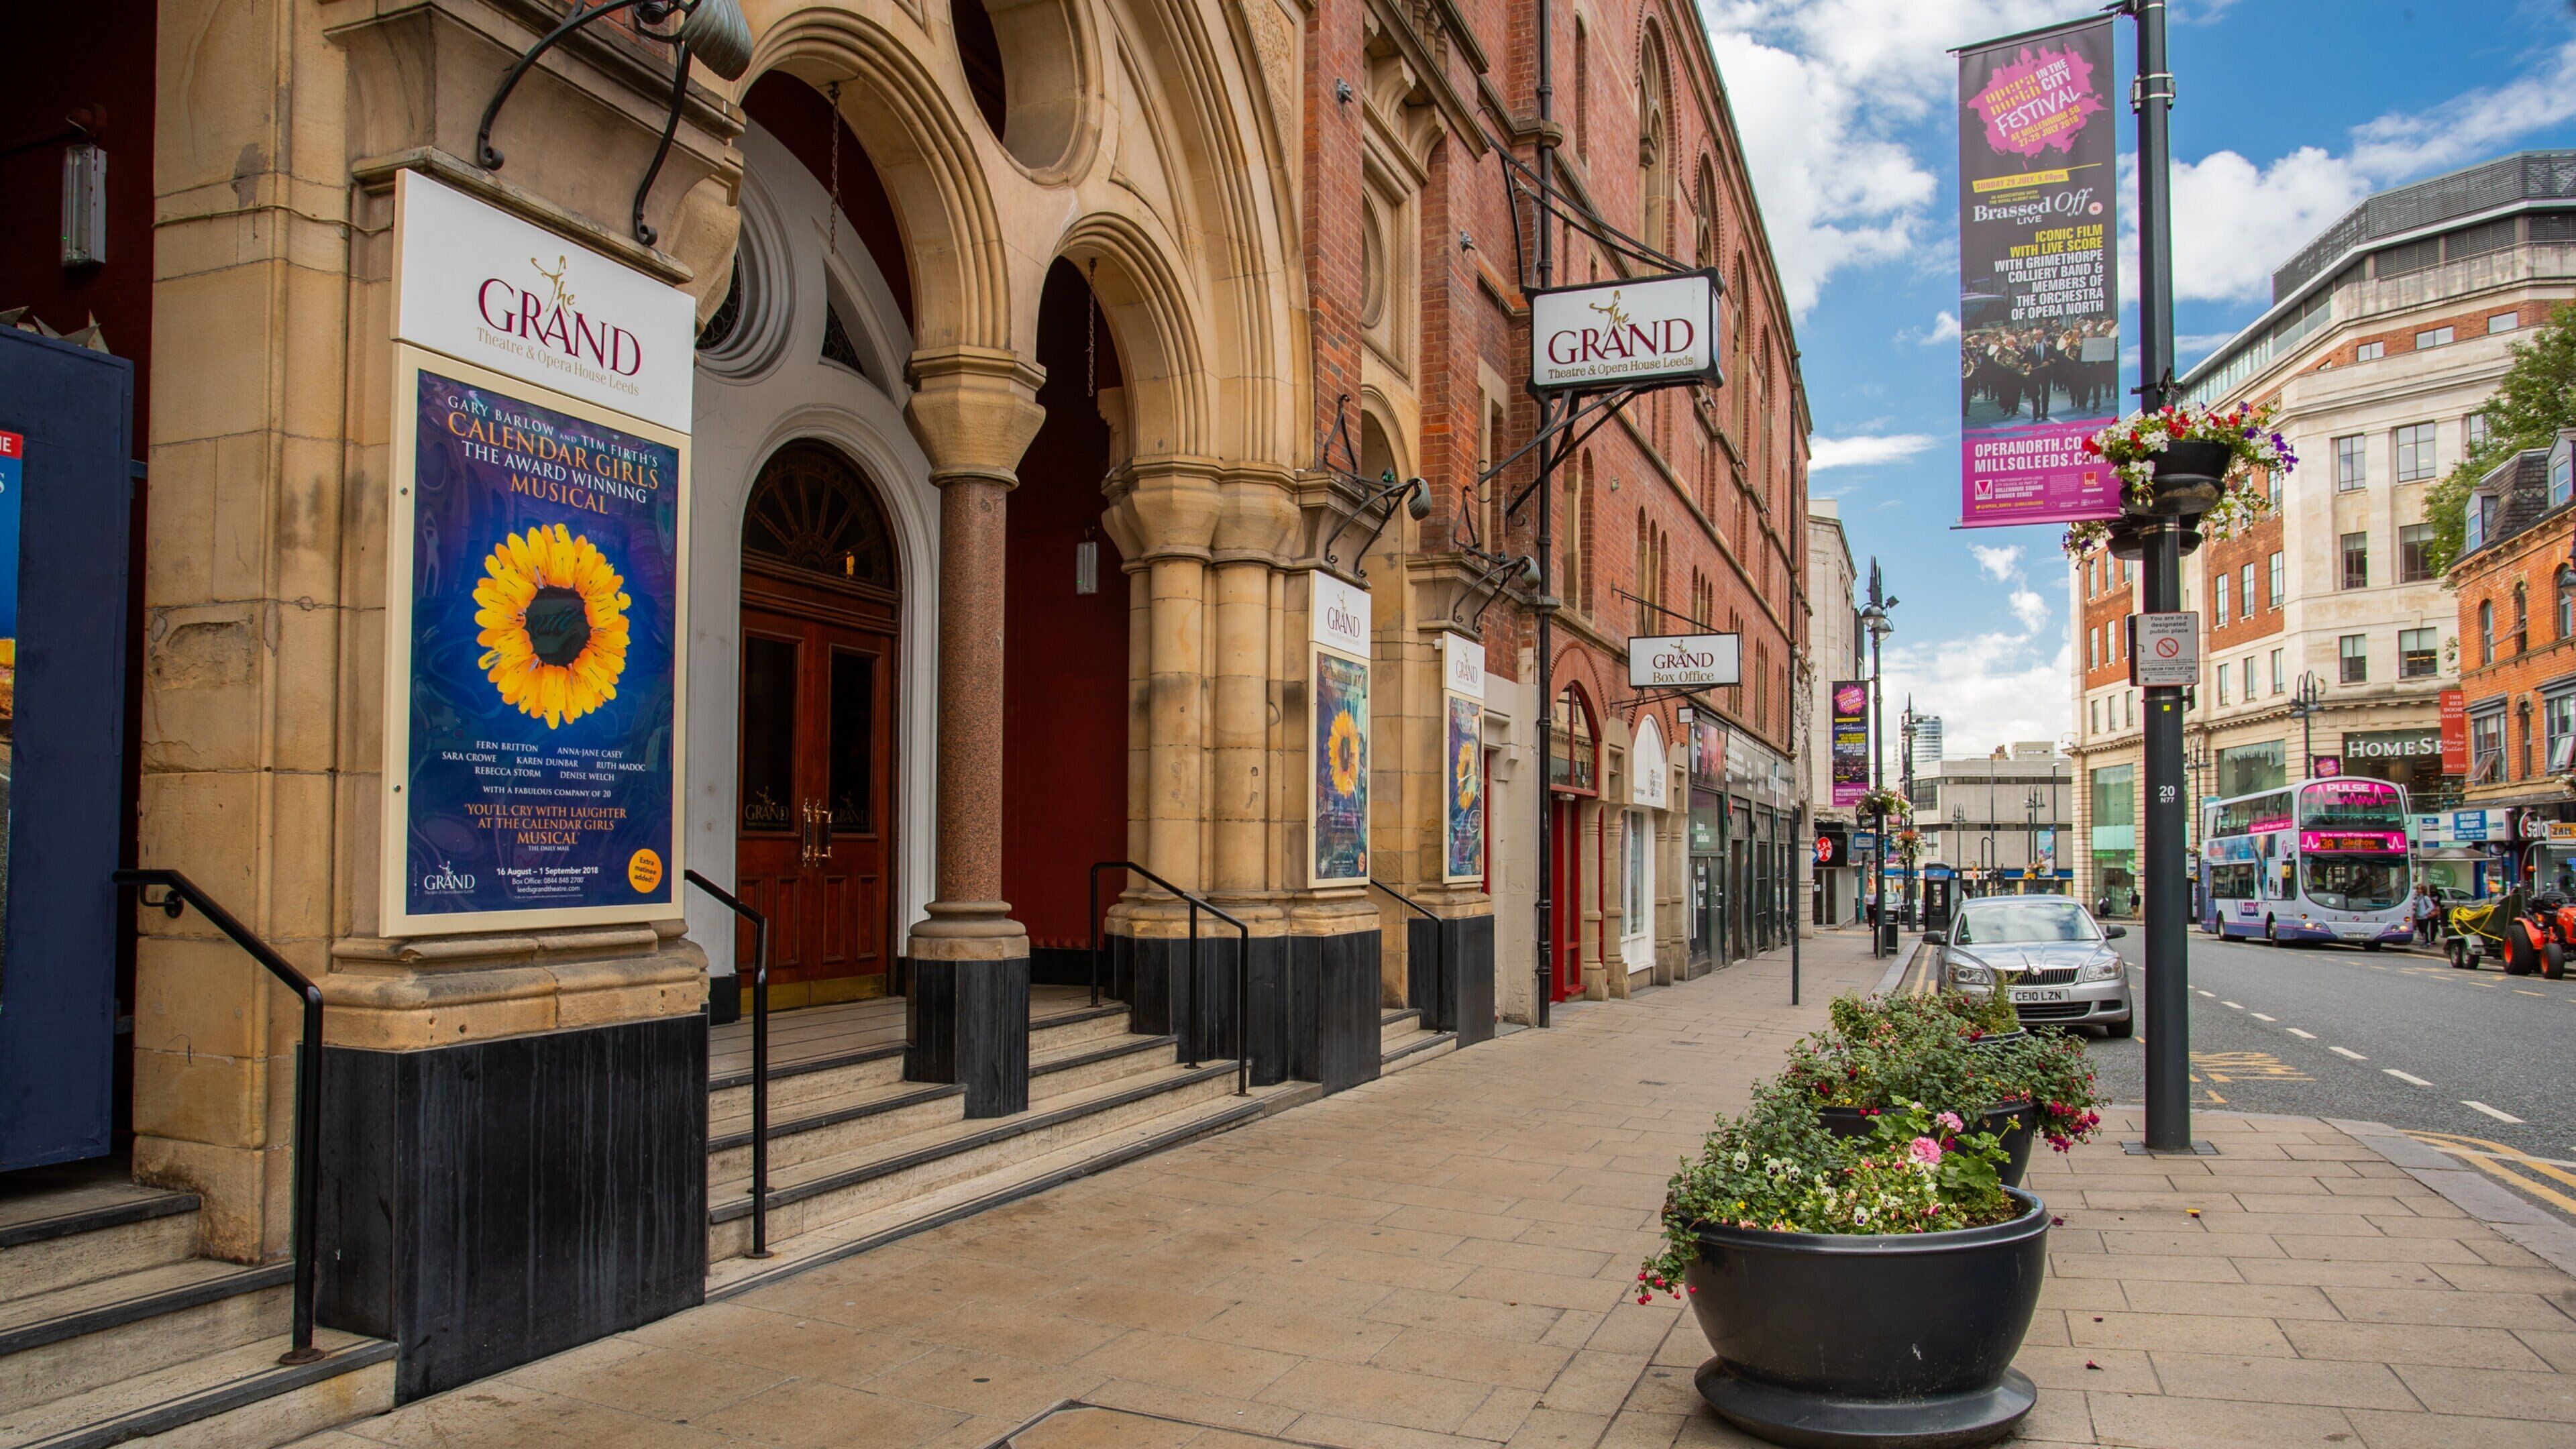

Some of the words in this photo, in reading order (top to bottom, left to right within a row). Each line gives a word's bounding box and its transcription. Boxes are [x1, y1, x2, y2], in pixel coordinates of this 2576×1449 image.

[2036, 68, 2048, 79] IN
[2047, 58, 2068, 74] THE
[2041, 67, 2071, 91] CITY
[1994, 85, 2080, 137] FESTIVAL
[2011, 131, 2020, 142] AT
[2021, 111, 2068, 136] MILLENNIUM
[2019, 132, 2040, 147] 27-29
[2042, 123, 2058, 137] JULY
[2060, 115, 2079, 129] 2018
[1976, 180, 2004, 190] SUNDAY
[1973, 196, 2051, 222] Brassed
[2055, 187, 2093, 217] Off
[2017, 215, 2042, 225] LIVE
[2035, 228, 2074, 243] ICONIC
[2077, 224, 2102, 237] FILM
[2010, 245, 2037, 258] WITH
[2041, 242, 2063, 254] LIVE
[2066, 237, 2102, 252] SCORE
[1994, 258, 2023, 272] WITH
[2026, 249, 2103, 268] GRIMETHORPE
[2008, 268, 2057, 284] COLLIERY
[2061, 263, 2090, 277] BAND
[2094, 262, 2103, 274] &
[531, 255, 575, 317] The
[2032, 276, 2086, 294] MEMBERS
[2089, 274, 2103, 287] OF
[2016, 294, 2036, 308] THE
[2039, 287, 2104, 305] ORCHESTRA
[1589, 290, 1629, 337] The
[2011, 307, 2025, 320] OF
[2028, 304, 2063, 319] OPERA
[2066, 300, 2104, 315] NORTH
[478, 278, 641, 376] GRAND
[1548, 318, 1695, 364] GRAND
[477, 327, 523, 356] Theatre
[526, 345, 535, 361] &
[538, 350, 572, 372] Opera
[574, 362, 606, 384] House
[609, 374, 639, 396] Leeds
[1548, 367, 1585, 379] Theatre
[1588, 365, 1597, 375] &
[1598, 363, 1627, 376] Opera
[1630, 360, 1660, 371] House
[1663, 355, 1693, 367] Leeds
[448, 396, 488, 417] GARY
[495, 409, 554, 436] BARLOW
[559, 433, 577, 443] AND
[582, 435, 606, 452] TIM
[611, 444, 658, 468] FIRTH'S
[448, 412, 590, 470] CALENDAR
[596, 454, 658, 490] GIRLS
[462, 440, 499, 465] THE
[504, 453, 567, 481] AWARD
[572, 470, 647, 503] WINNING
[511, 473, 608, 515] MUSICAL
[1327, 606, 1360, 638] GRAND
[1653, 653, 1714, 669] GRAND
[1456, 659, 1478, 684] GRAND
[1653, 672, 1675, 683] Box
[1679, 671, 1714, 682] Office
[1841, 696, 1862, 708] FESTIVAL
[476, 741, 498, 750] FERN
[501, 743, 538, 752] BRITTON
[557, 747, 599, 757] ANNA-JANE
[601, 750, 623, 759] CASEY
[442, 751, 464, 761] SARA
[466, 753, 496, 763] CROWE
[517, 756, 543, 765] KAREN
[545, 758, 578, 767] DUNBAR
[596, 761, 616, 770] RUTH
[619, 763, 645, 771] MADOC
[475, 766, 511, 776] REBECCA
[513, 768, 541, 777] STORM
[560, 771, 586, 780] DENISE
[588, 773, 614, 782] WELCH
[483, 786, 504, 794] WITH
[515, 787, 552, 795] FABULOUS
[554, 789, 590, 797] COMPANY
[2159, 786, 2175, 796] 20
[2326, 784, 2370, 792] PULSE
[464, 804, 508, 816] 'YOU'LL
[511, 805, 533, 816] CRY
[535, 806, 566, 816] WITH
[571, 806, 627, 818] LAUGHTER
[745, 804, 790, 821] GRAND
[478, 818, 492, 828] AT
[496, 818, 519, 829] THE
[522, 818, 582, 829] CALENDAR
[584, 820, 614, 830] GIRLS
[635, 866, 657, 875] matinee
[639, 857, 654, 865] Extra
[424, 874, 475, 890] GRAND
[507, 867, 531, 877] August
[545, 867, 582, 875] September
[634, 874, 655, 883] added!
[517, 886, 580, 894] leedsgrandtheatre.com
[2015, 991, 2038, 1002] CE10
[2041, 991, 2061, 1000] LZN
